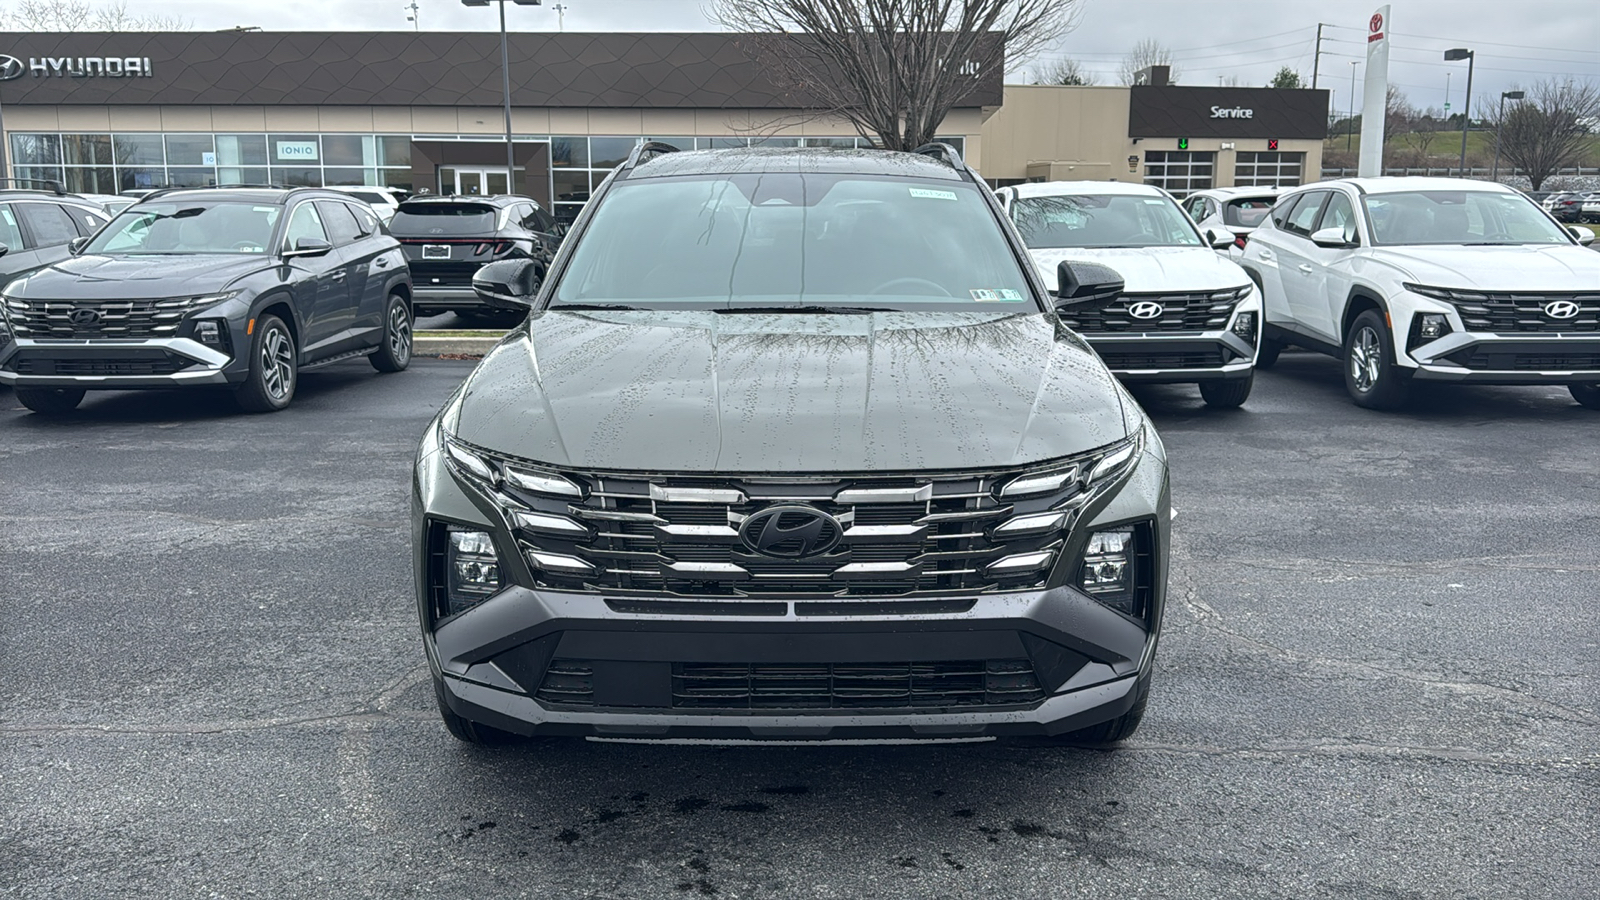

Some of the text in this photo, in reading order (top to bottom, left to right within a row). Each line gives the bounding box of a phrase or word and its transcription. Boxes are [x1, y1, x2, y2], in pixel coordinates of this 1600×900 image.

[29, 57, 152, 77] HYUNDAI
[1210, 105, 1253, 119] Service
[281, 146, 313, 154] IONIQ
